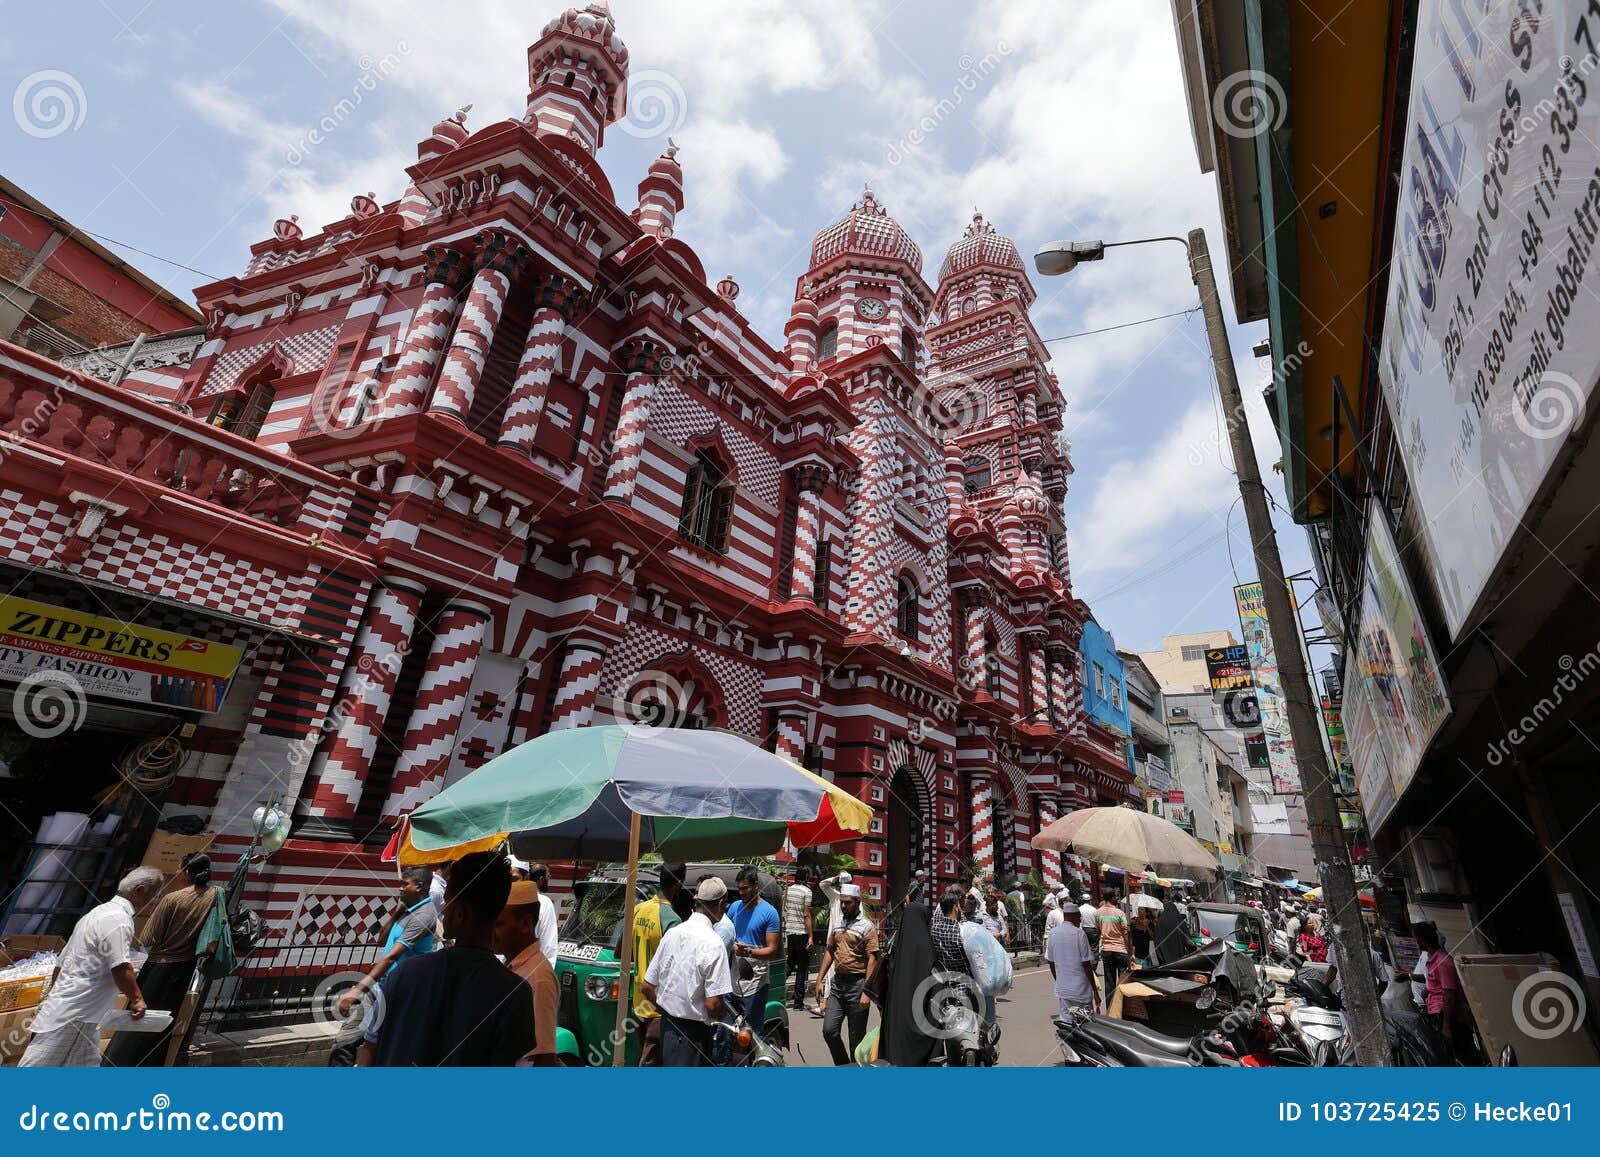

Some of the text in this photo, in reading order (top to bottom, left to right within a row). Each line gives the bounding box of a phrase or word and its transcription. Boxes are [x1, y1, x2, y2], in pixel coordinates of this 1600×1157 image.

[1465, 208, 1492, 299] 2nd
[1482, 78, 1521, 220] Cross
[1513, 329, 1552, 416] Email:
[8, 611, 173, 662] ZIPPERS
[13, 637, 68, 654] AMONGST
[68, 649, 114, 663] ZIPPERS
[35, 655, 135, 683] FASHION
[1211, 675, 1251, 689] HAPPY
